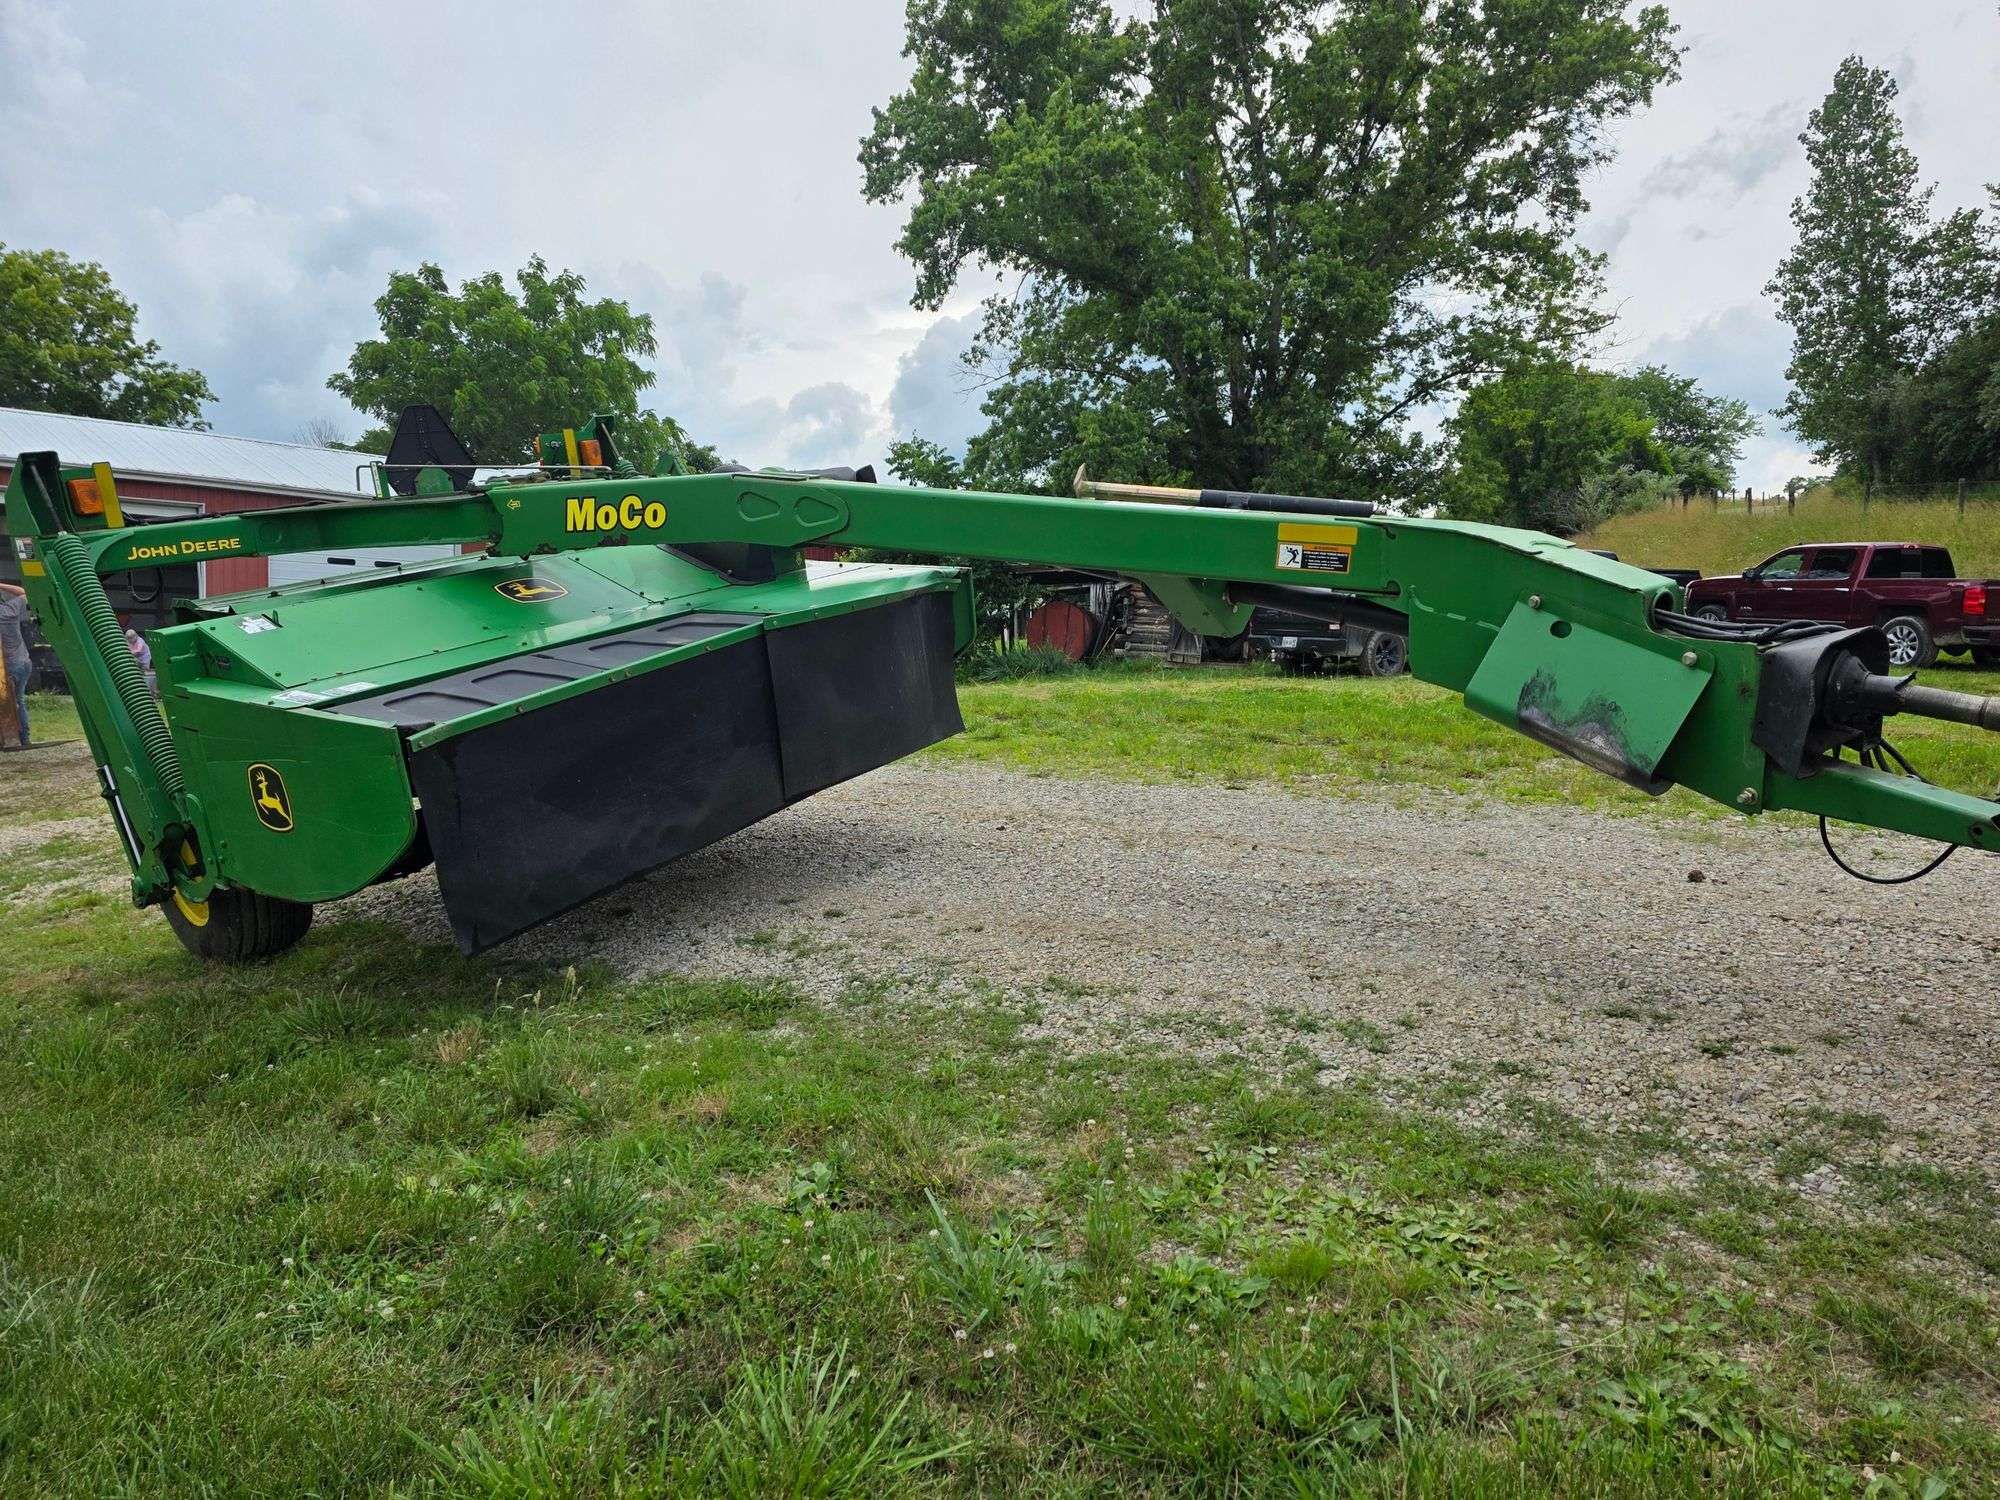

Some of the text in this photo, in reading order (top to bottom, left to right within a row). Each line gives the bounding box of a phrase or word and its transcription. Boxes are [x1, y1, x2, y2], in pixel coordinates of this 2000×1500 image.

[565, 494, 667, 533] MoCo
[128, 538, 241, 560] JOHN DEERE
